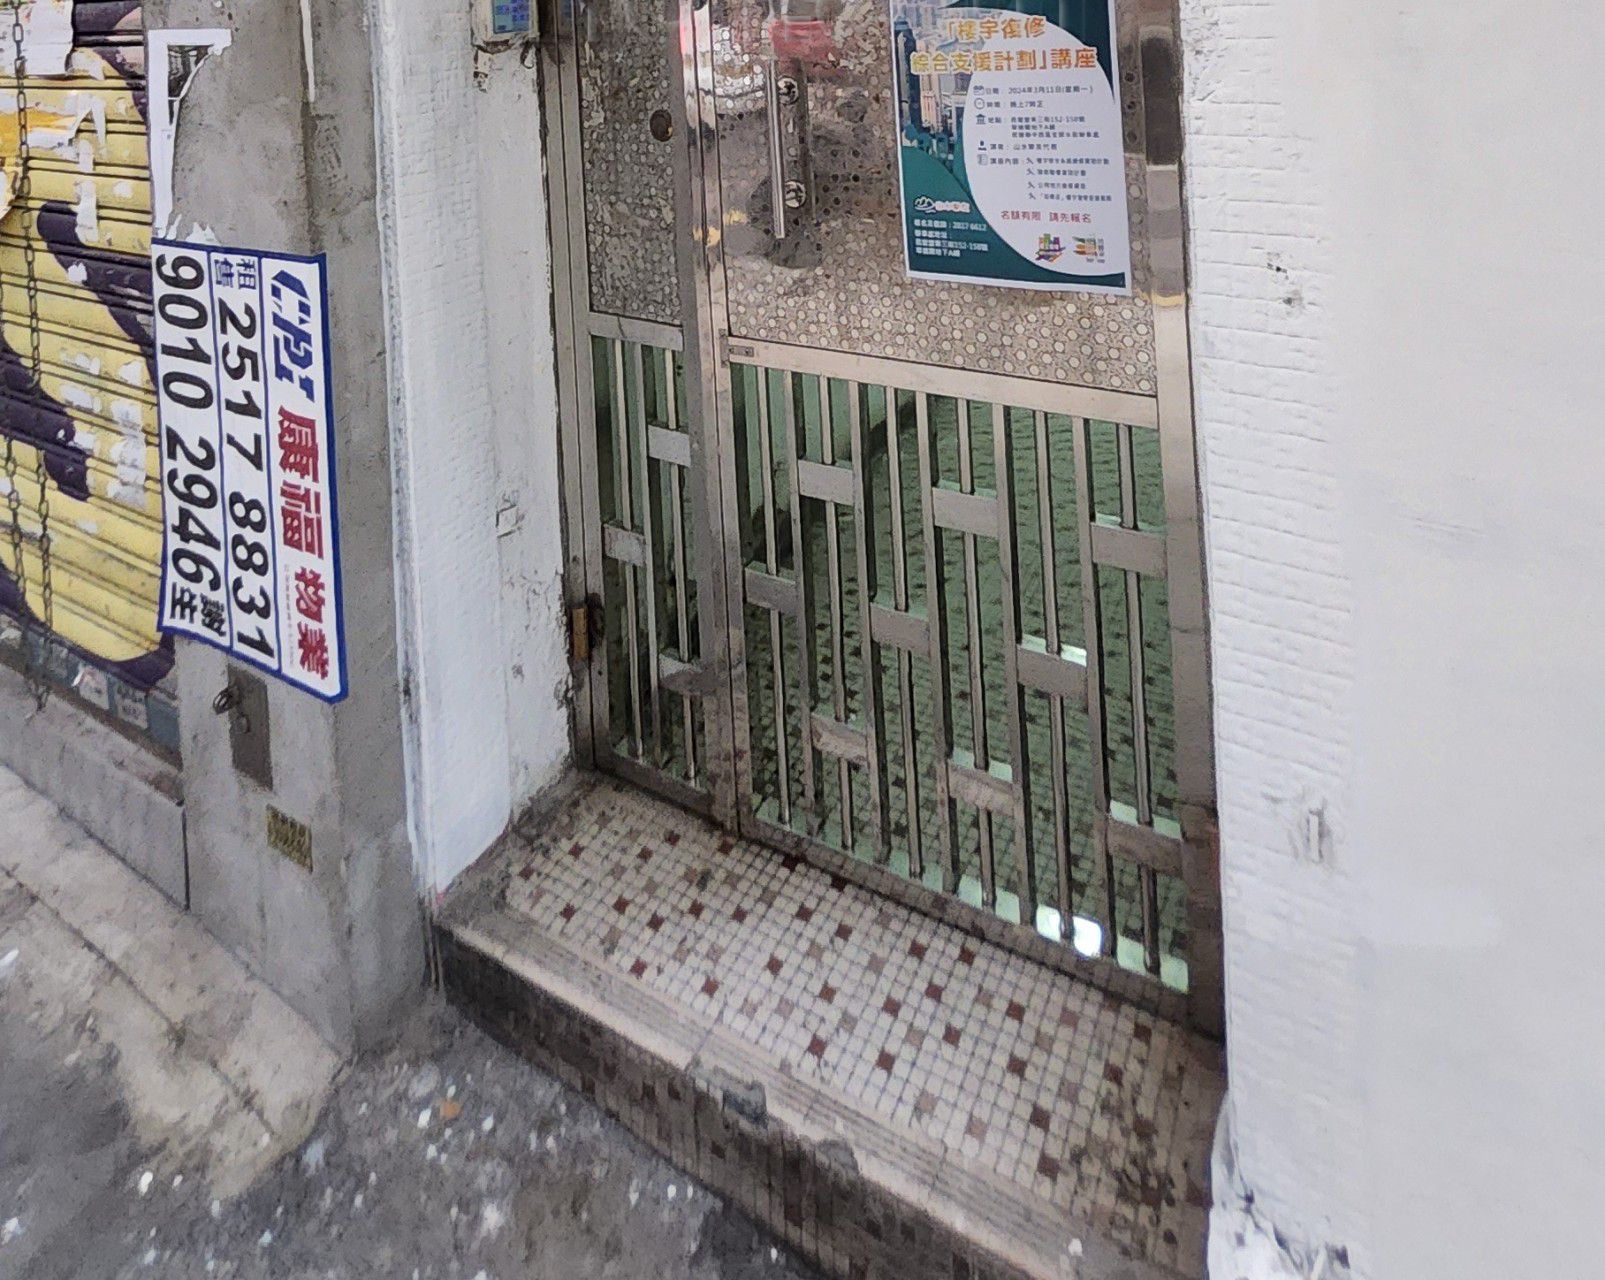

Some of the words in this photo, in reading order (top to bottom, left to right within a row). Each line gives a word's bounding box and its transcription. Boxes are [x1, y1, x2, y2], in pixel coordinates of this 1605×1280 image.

[155, 253, 214, 410] 9010
[218, 297, 264, 472] 2517
[165, 424, 222, 592] 2946
[229, 491, 275, 659] 8831
